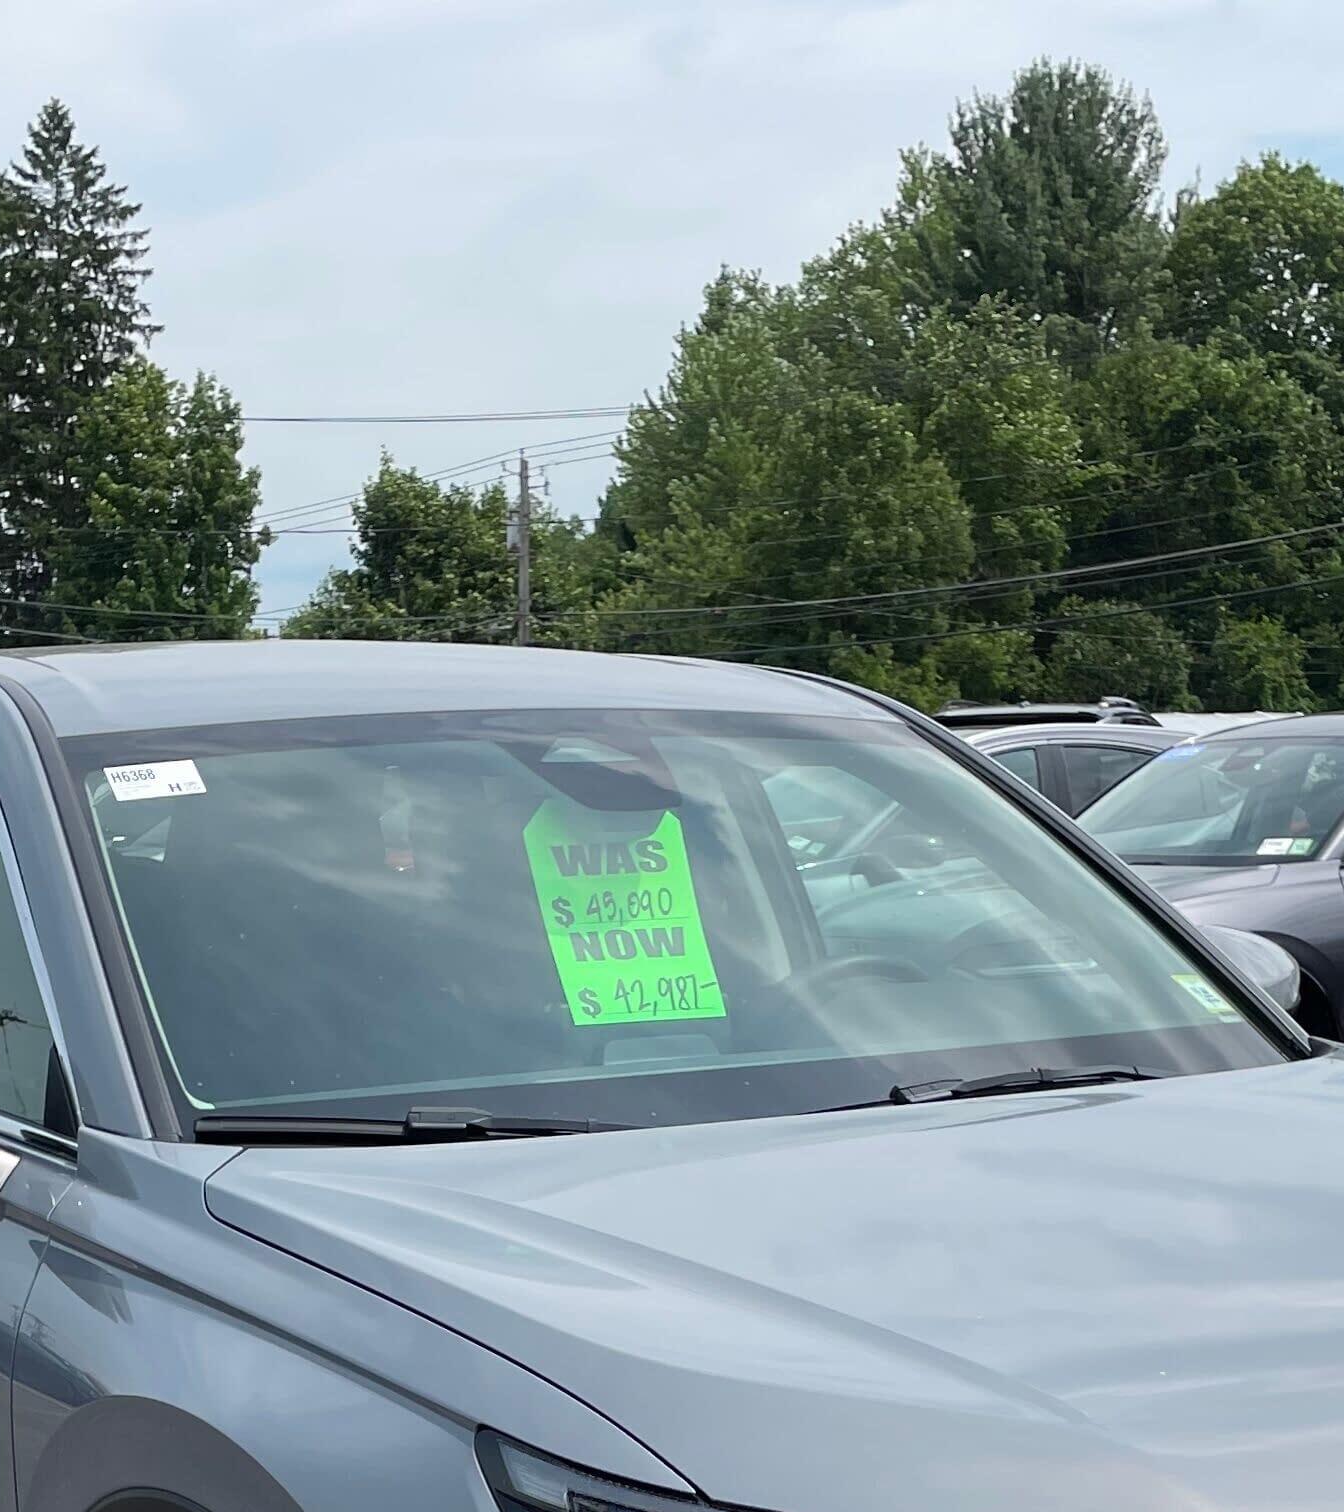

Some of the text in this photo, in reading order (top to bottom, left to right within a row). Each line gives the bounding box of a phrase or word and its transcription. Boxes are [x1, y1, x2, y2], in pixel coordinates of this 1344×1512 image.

[111, 768, 156, 783] H6368
[550, 840, 668, 878] WAS
[552, 896, 575, 928] $
[569, 927, 686, 962] NOW
[578, 987, 602, 1018] $
